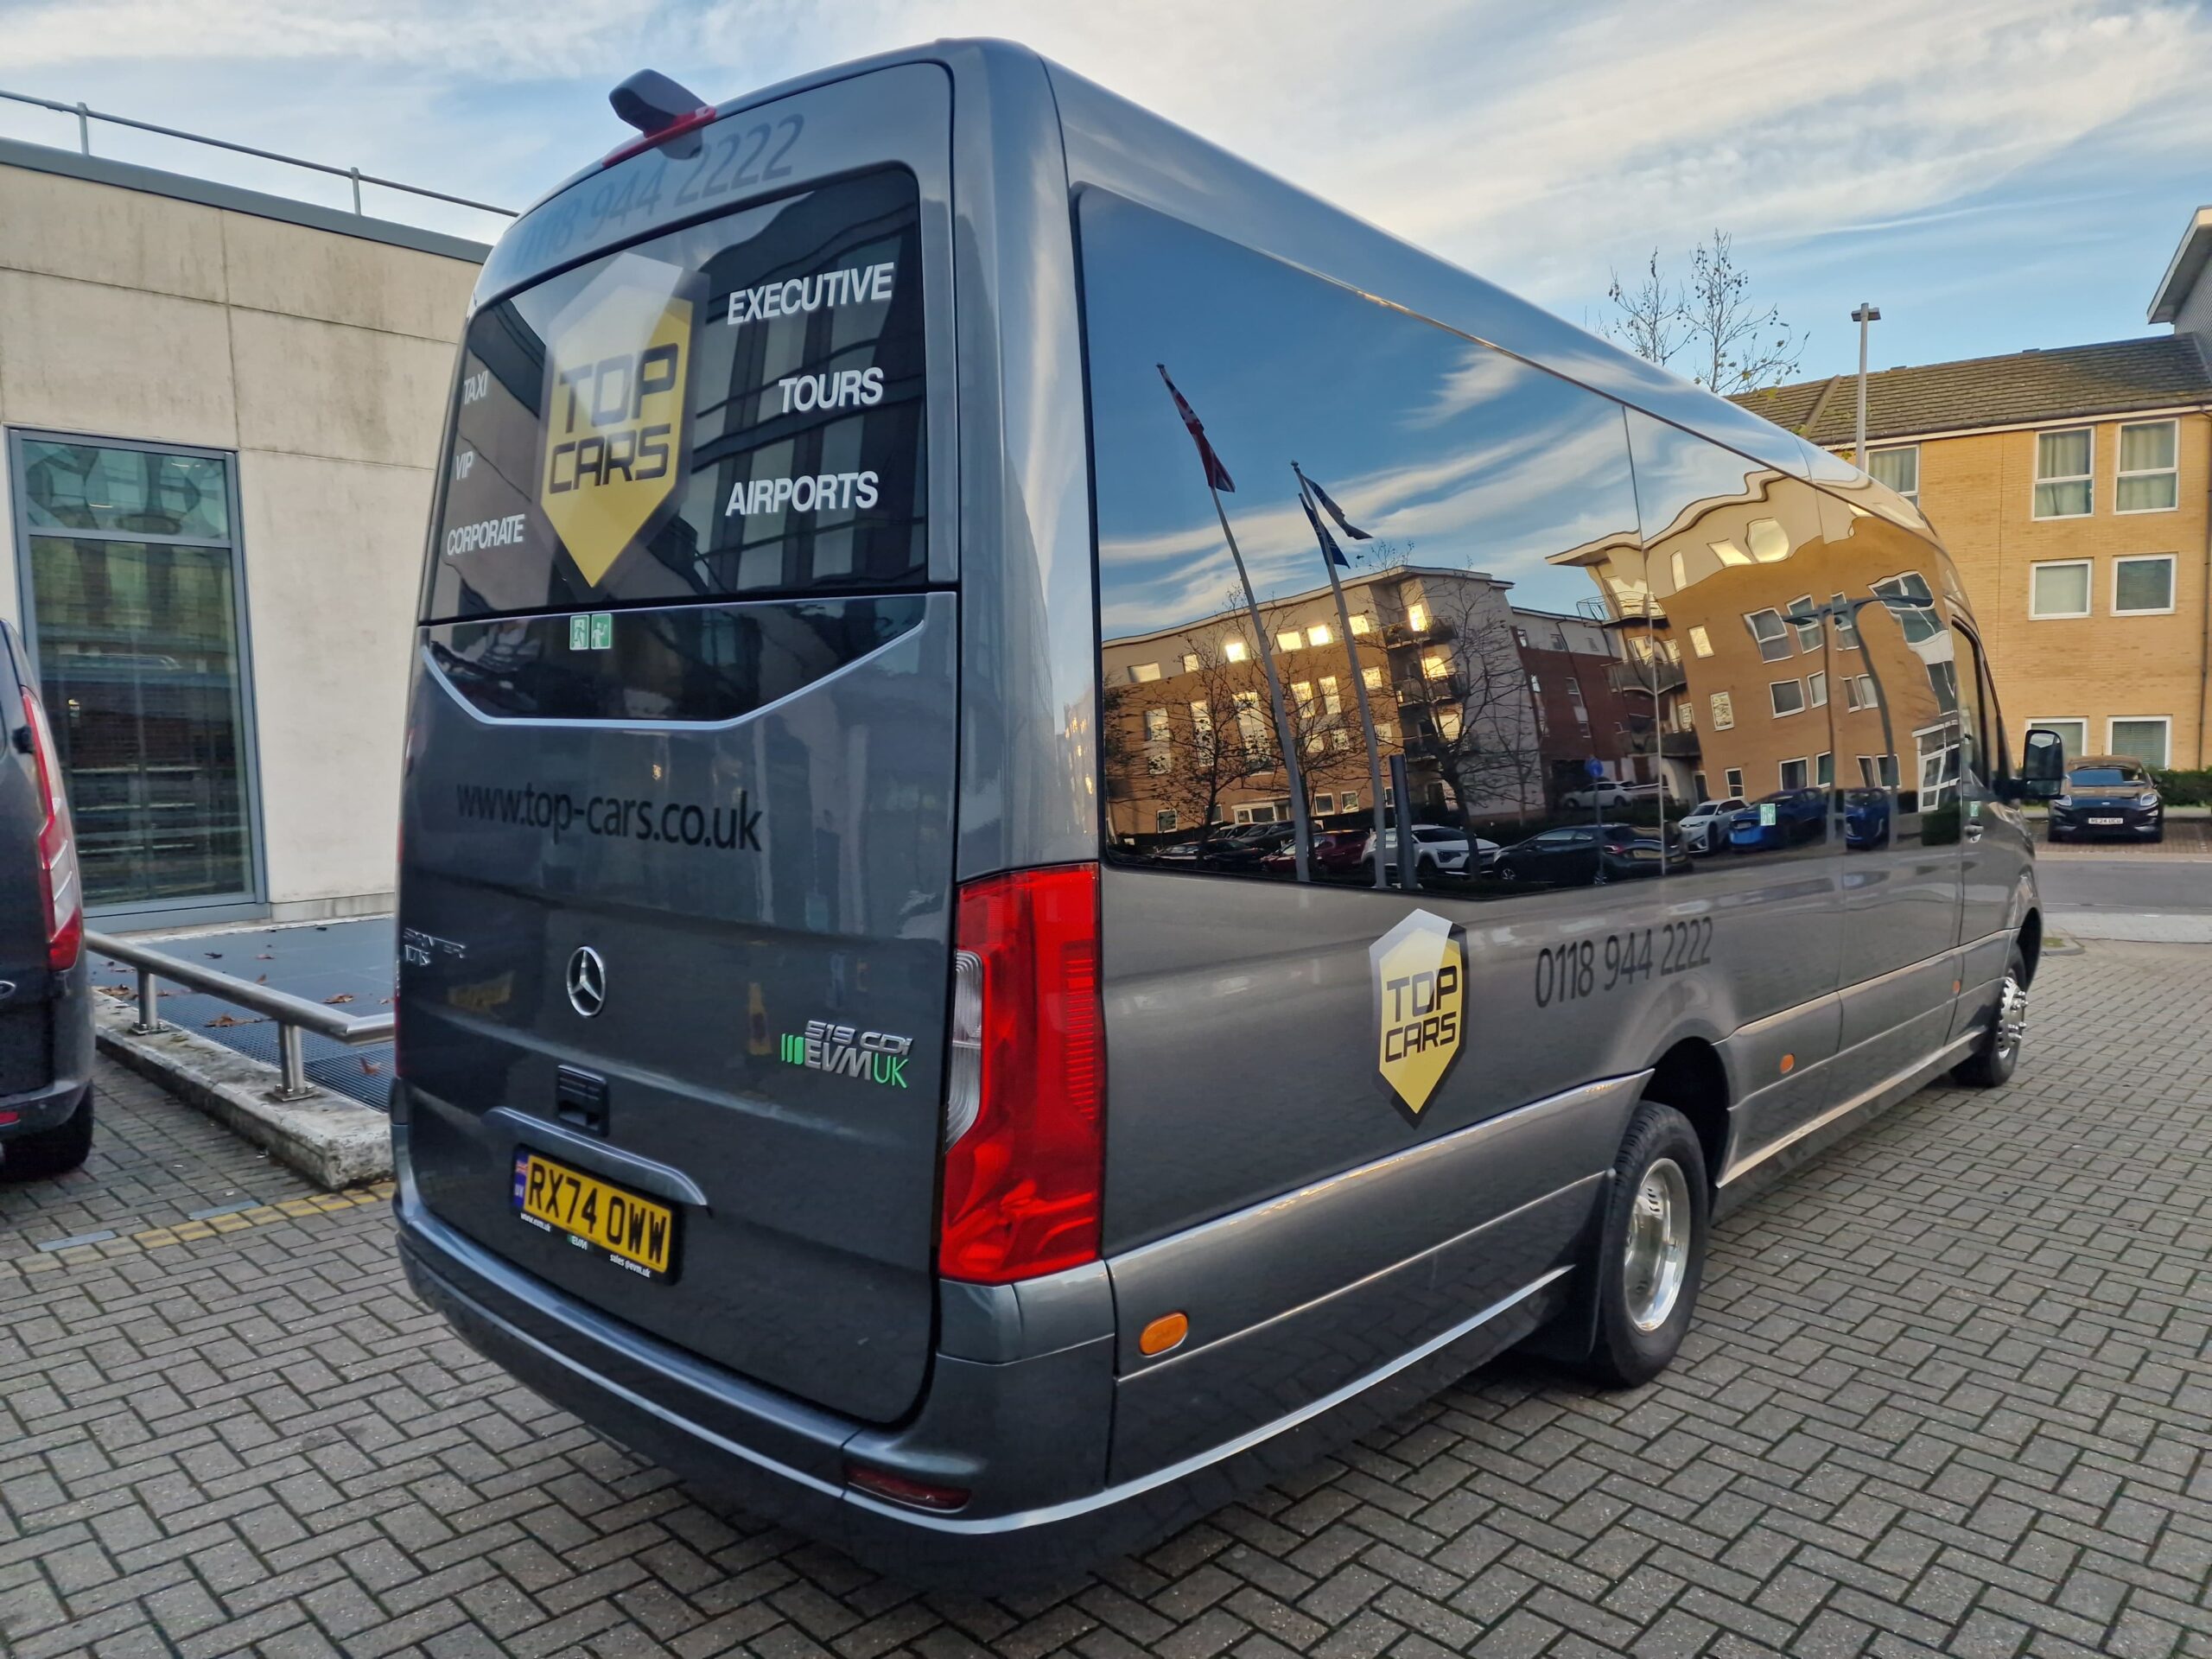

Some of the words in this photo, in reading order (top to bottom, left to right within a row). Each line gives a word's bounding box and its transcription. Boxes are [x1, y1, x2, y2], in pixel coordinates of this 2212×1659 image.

[584, 157, 668, 240] 944
[674, 113, 804, 207] 2222
[727, 262, 894, 326] EXECUTIVE
[464, 370, 488, 404] TAXI
[558, 342, 678, 434] TOP
[779, 366, 884, 414] TOURS
[456, 451, 473, 480] VIP
[549, 423, 671, 494] CARS
[725, 471, 879, 517] AIRPORTS
[447, 514, 525, 556] CORPORATE
[457, 781, 763, 852] www.top-cars.co.uk
[1535, 939, 1595, 1008] 0118
[1604, 928, 1653, 991] 944
[1660, 916, 1713, 977] 2222
[1386, 964, 1458, 1023] TOP
[804, 1020, 856, 1046] 519
[1385, 1012, 1457, 1063] CARS
[529, 1162, 598, 1235] RX74
[607, 1195, 667, 1264] OWW
